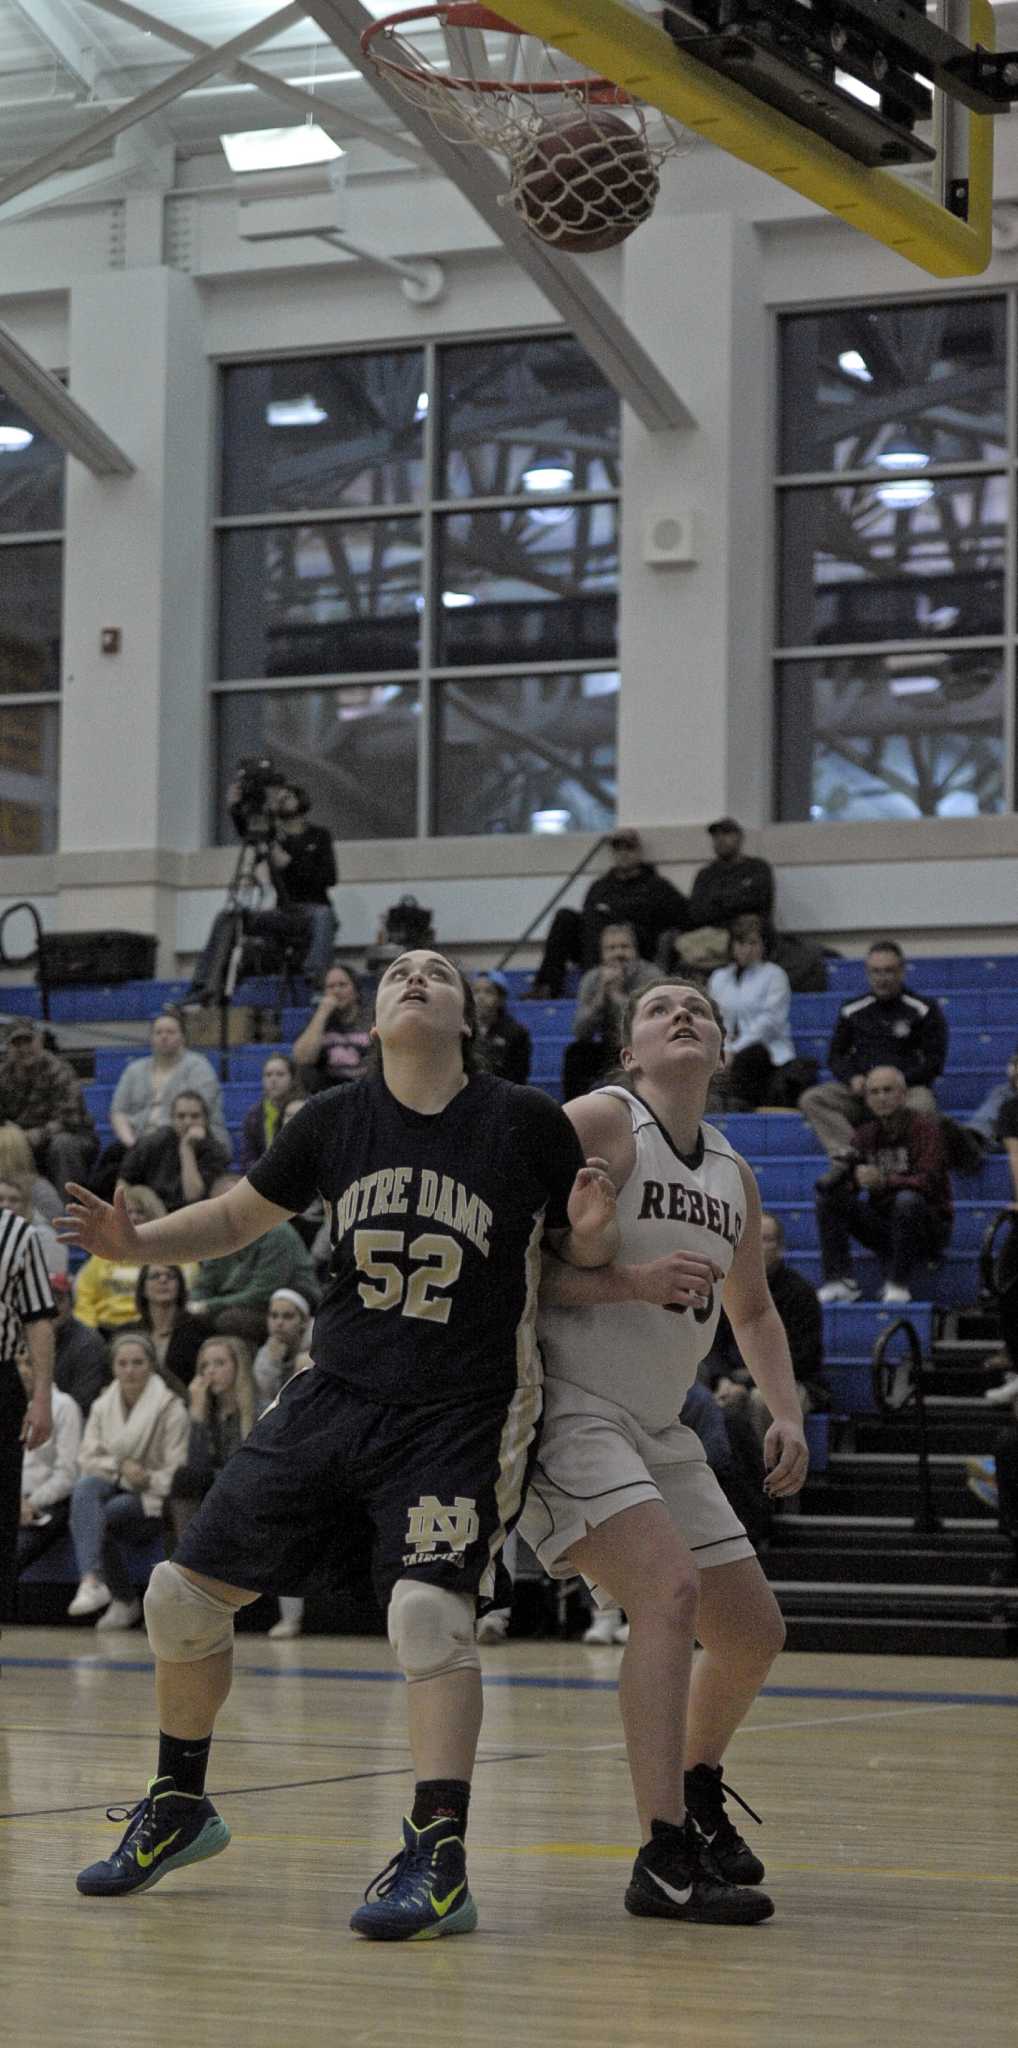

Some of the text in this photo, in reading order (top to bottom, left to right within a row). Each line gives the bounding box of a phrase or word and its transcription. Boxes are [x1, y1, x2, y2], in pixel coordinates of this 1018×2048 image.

[416, 1168, 493, 1258] DAME
[637, 1180, 742, 1249] REBELS
[354, 1229, 463, 1324] 52
